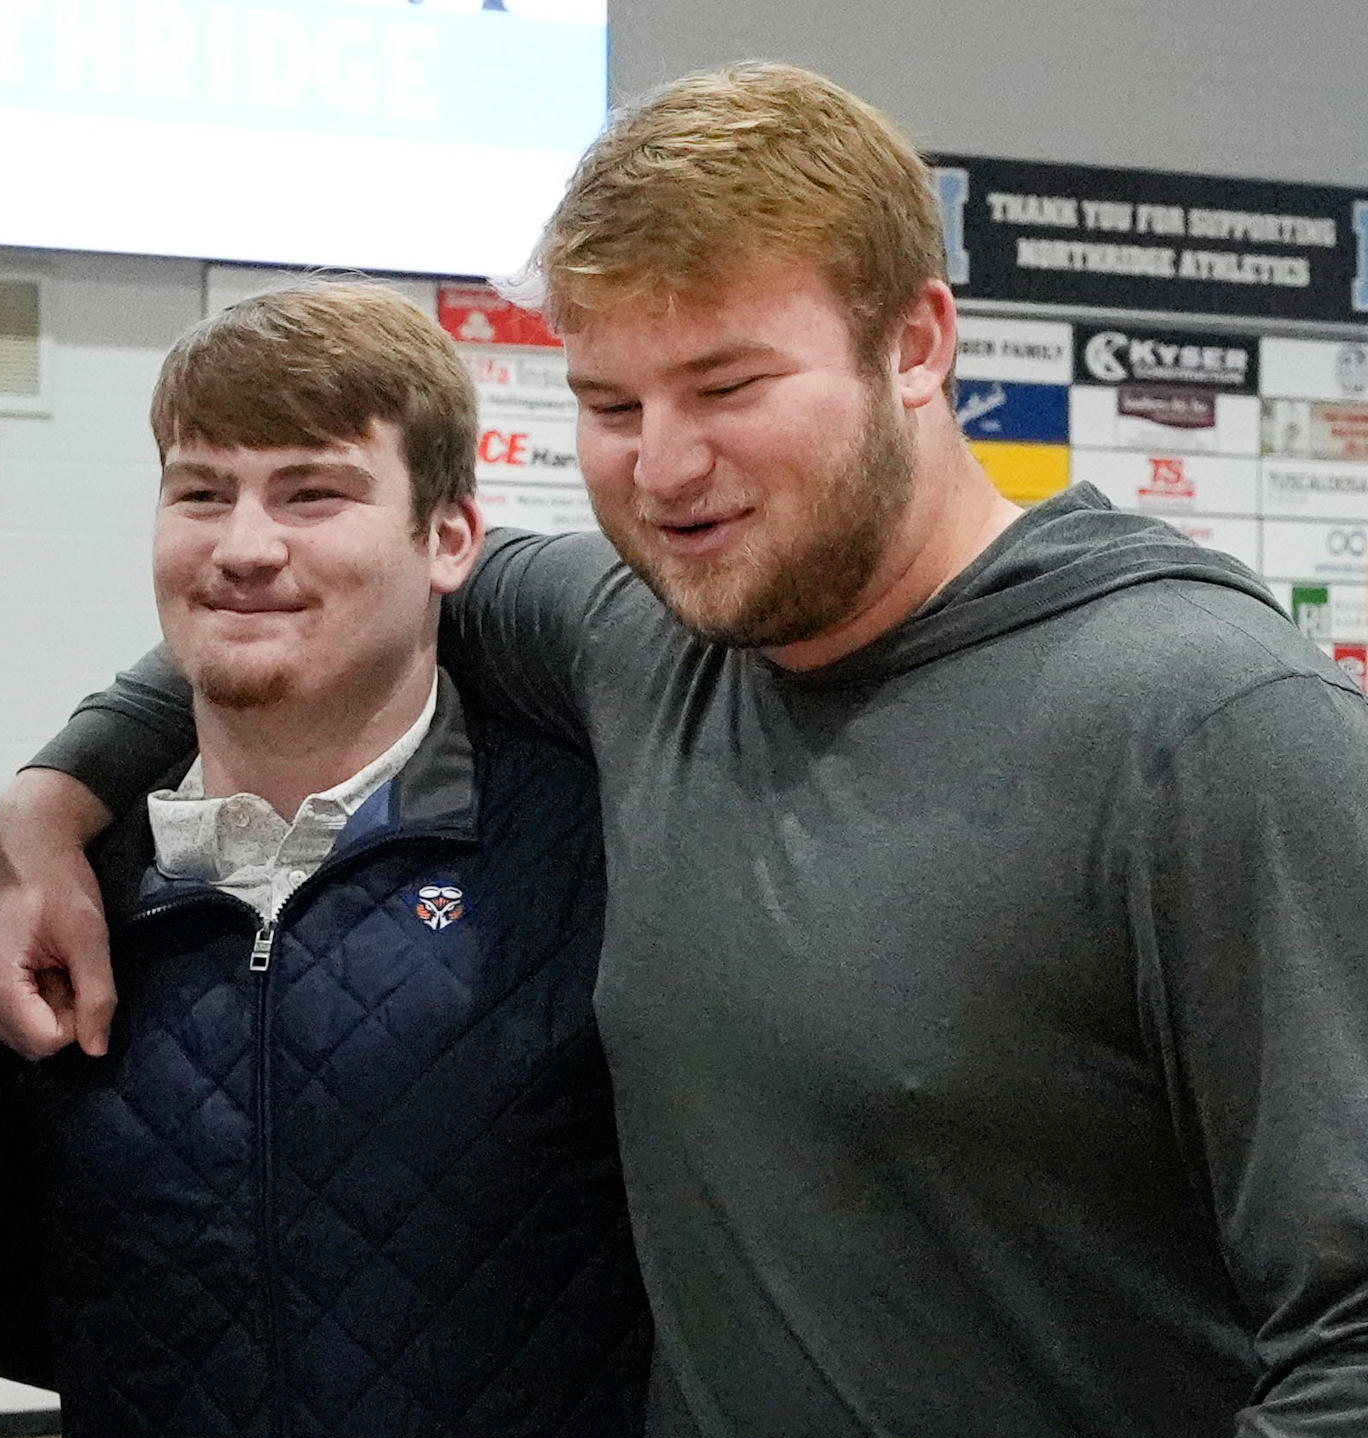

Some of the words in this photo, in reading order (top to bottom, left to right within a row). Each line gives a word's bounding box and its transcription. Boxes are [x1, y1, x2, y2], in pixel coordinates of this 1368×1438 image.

[986, 192, 1079, 228] THANK
[1082, 199, 1133, 233] YOU
[1136, 203, 1186, 235] FOR
[1187, 207, 1337, 248] SUPPORTING
[1016, 238, 1177, 279] NORTHRIDGE
[1180, 248, 1311, 287] ATHLETICS
